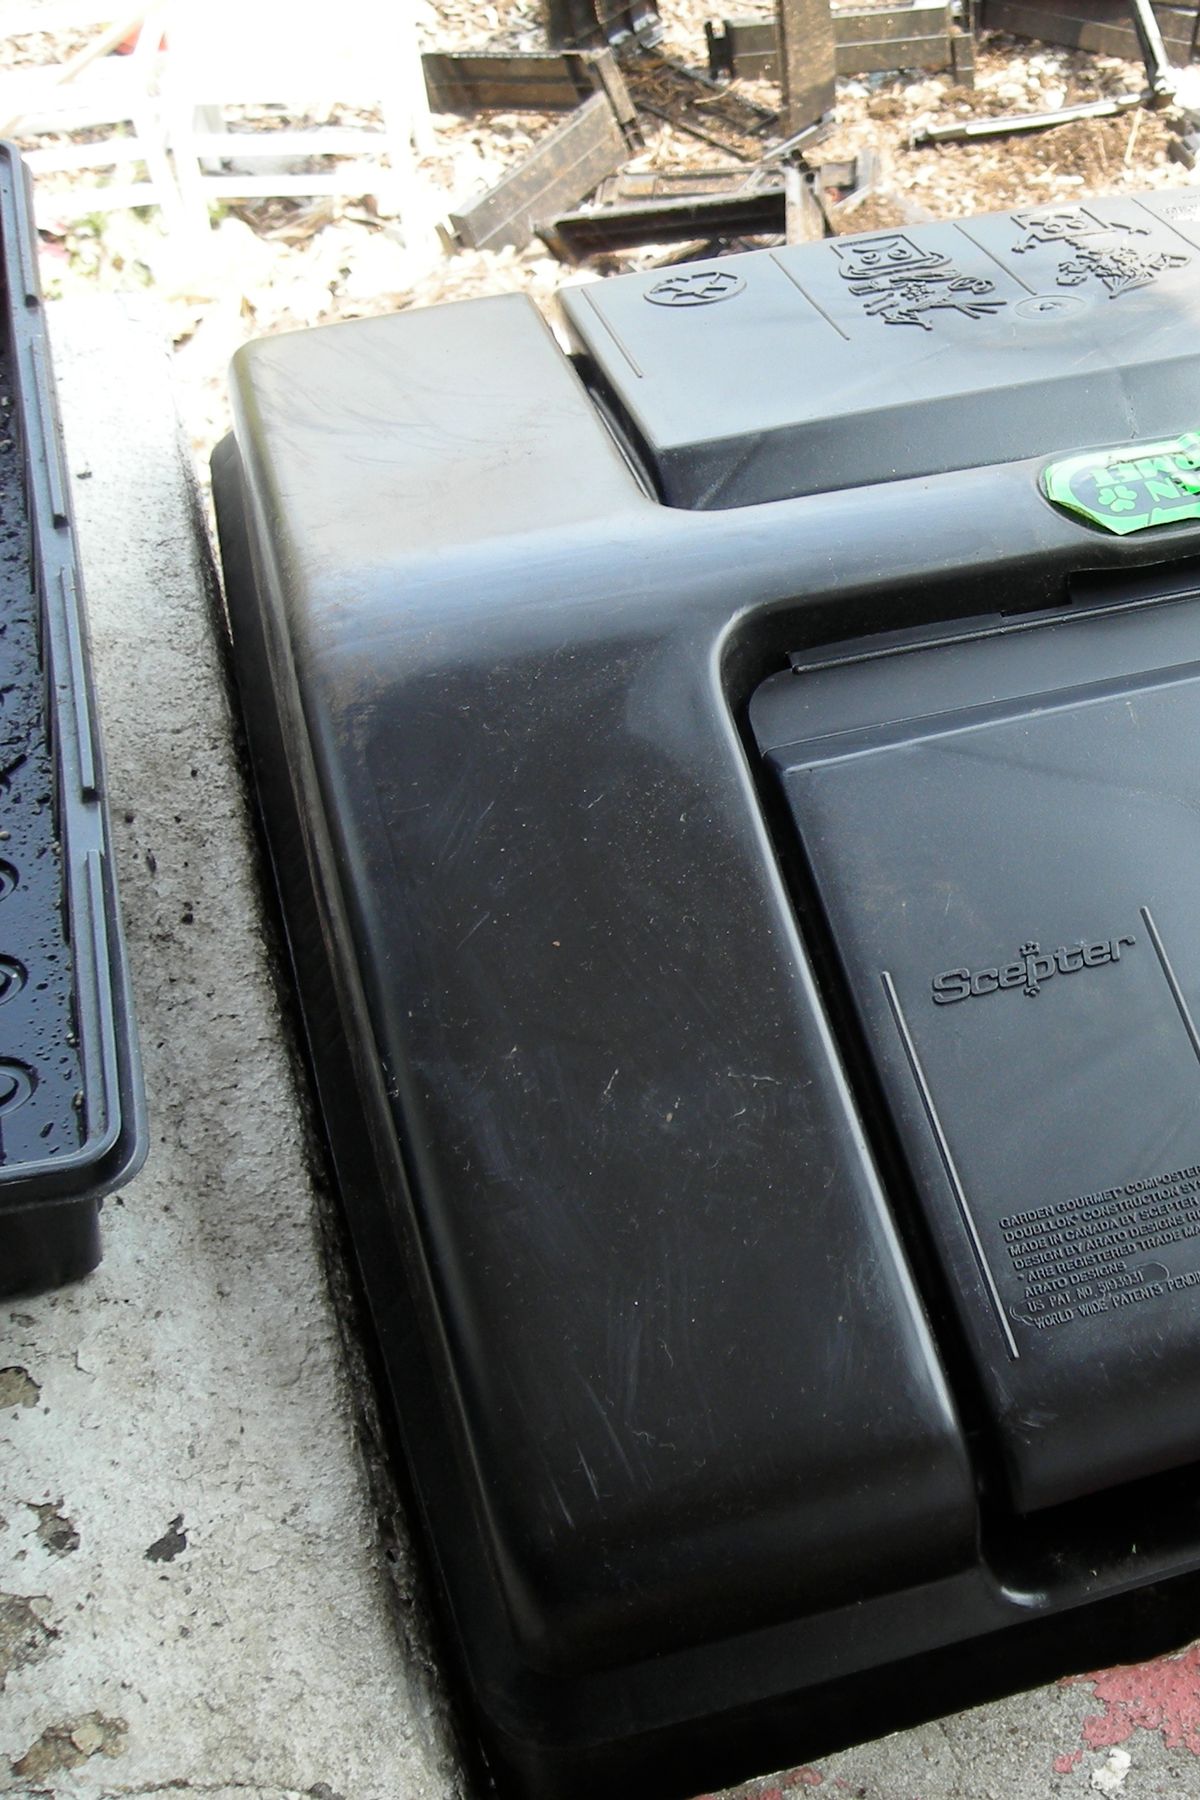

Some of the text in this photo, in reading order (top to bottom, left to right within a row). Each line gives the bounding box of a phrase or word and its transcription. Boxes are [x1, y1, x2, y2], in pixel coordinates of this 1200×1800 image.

[932, 935, 1136, 1005] Scepter
[1000, 1205, 1055, 1229] GARDEN
[1008, 1196, 1200, 1258] MADE IN CANADA BY SCEPTER
[1082, 1185, 1180, 1222] CONSTRUCTION
[1013, 1248, 1065, 1271] DESIGN
[1065, 1241, 1083, 1256] BY
[1085, 1230, 1128, 1252] ARATO
[1129, 1214, 1185, 1238] DESIGNS
[1027, 1265, 1056, 1283] ARE
[1056, 1243, 1138, 1275] REGISTERED
[1136, 1230, 1181, 1252] TRADE
[1023, 1259, 1128, 1298] ARATO DESIGNS
[1025, 1300, 1045, 1314] US
[1033, 1308, 1074, 1330] WORLD
[1075, 1300, 1109, 1317] WIDE
[1111, 1283, 1164, 1307] PATENTS
